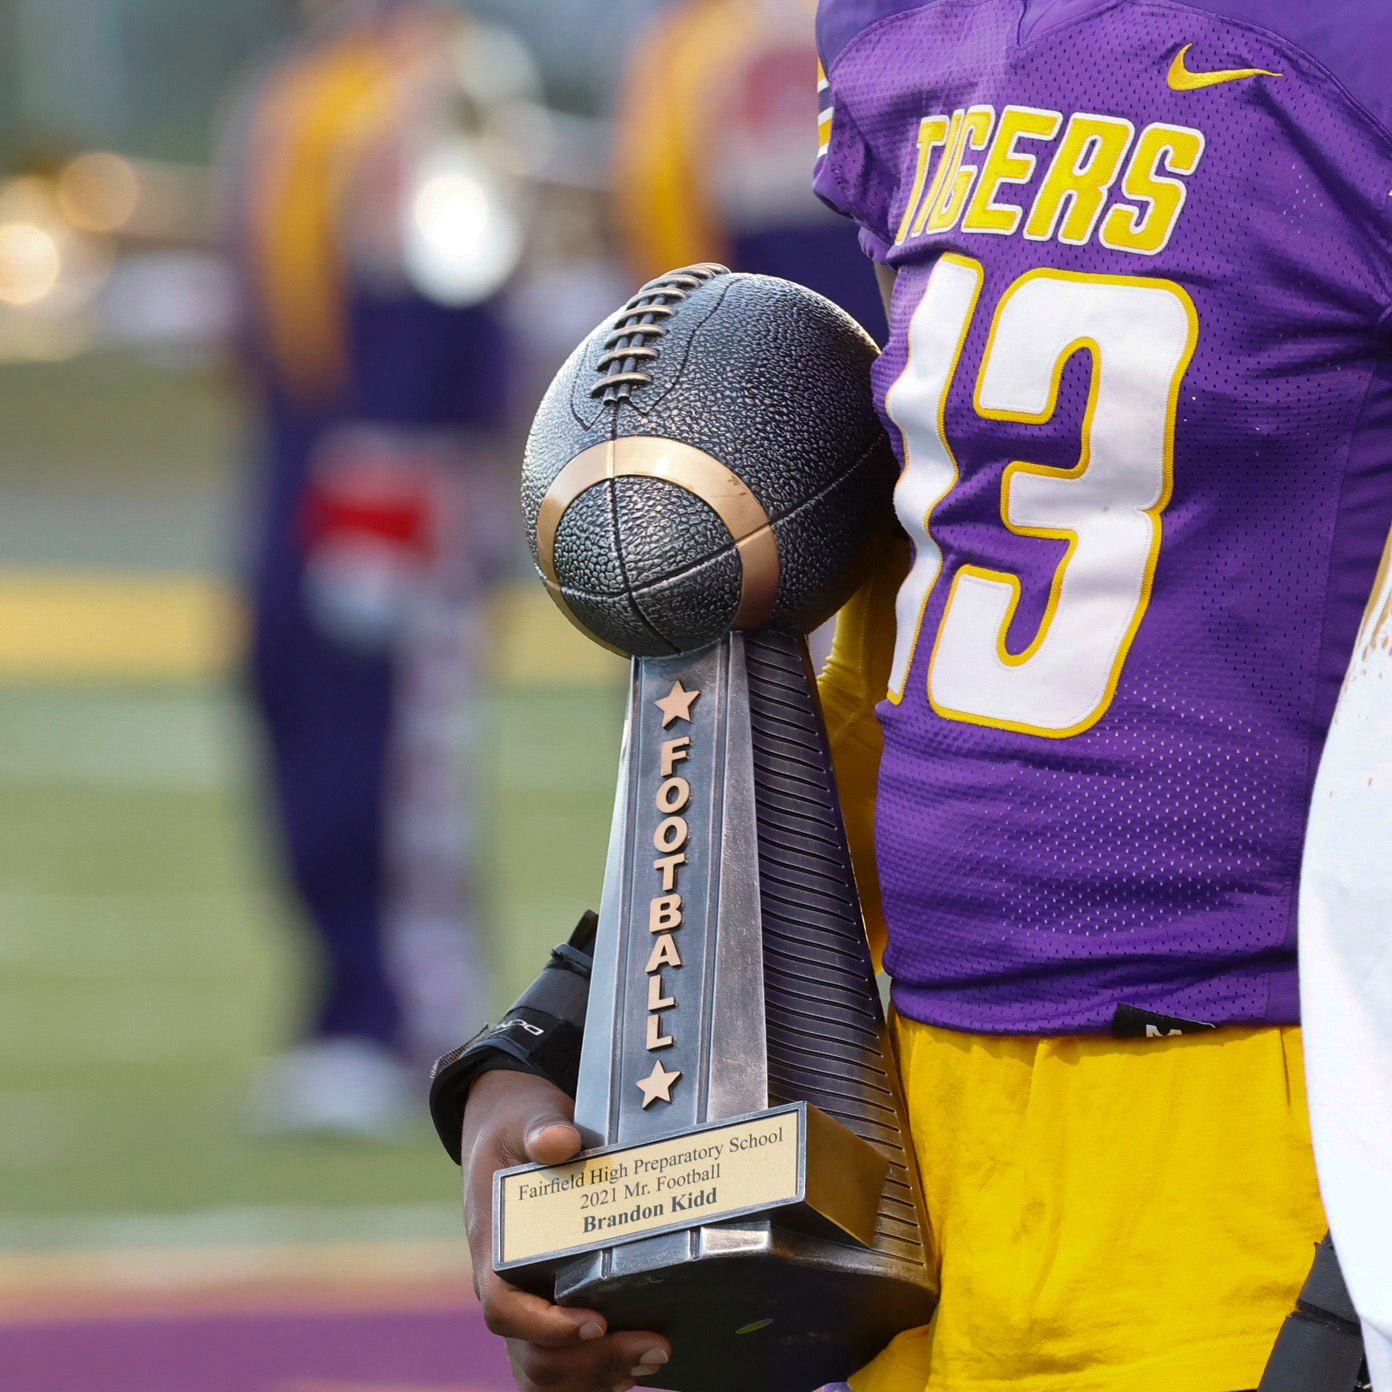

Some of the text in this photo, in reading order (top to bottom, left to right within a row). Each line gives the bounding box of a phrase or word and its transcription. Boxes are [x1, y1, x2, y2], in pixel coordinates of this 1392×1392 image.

[894, 104, 1206, 256] TIGERS
[885, 251, 1199, 740] 13
[644, 736, 693, 1051] FOOTBALL
[518, 1127, 784, 1200] Fairfield High Preparatory School
[579, 1163, 721, 1210] 2021 Mr. Football
[582, 1187, 718, 1234] Brandon Kidd
